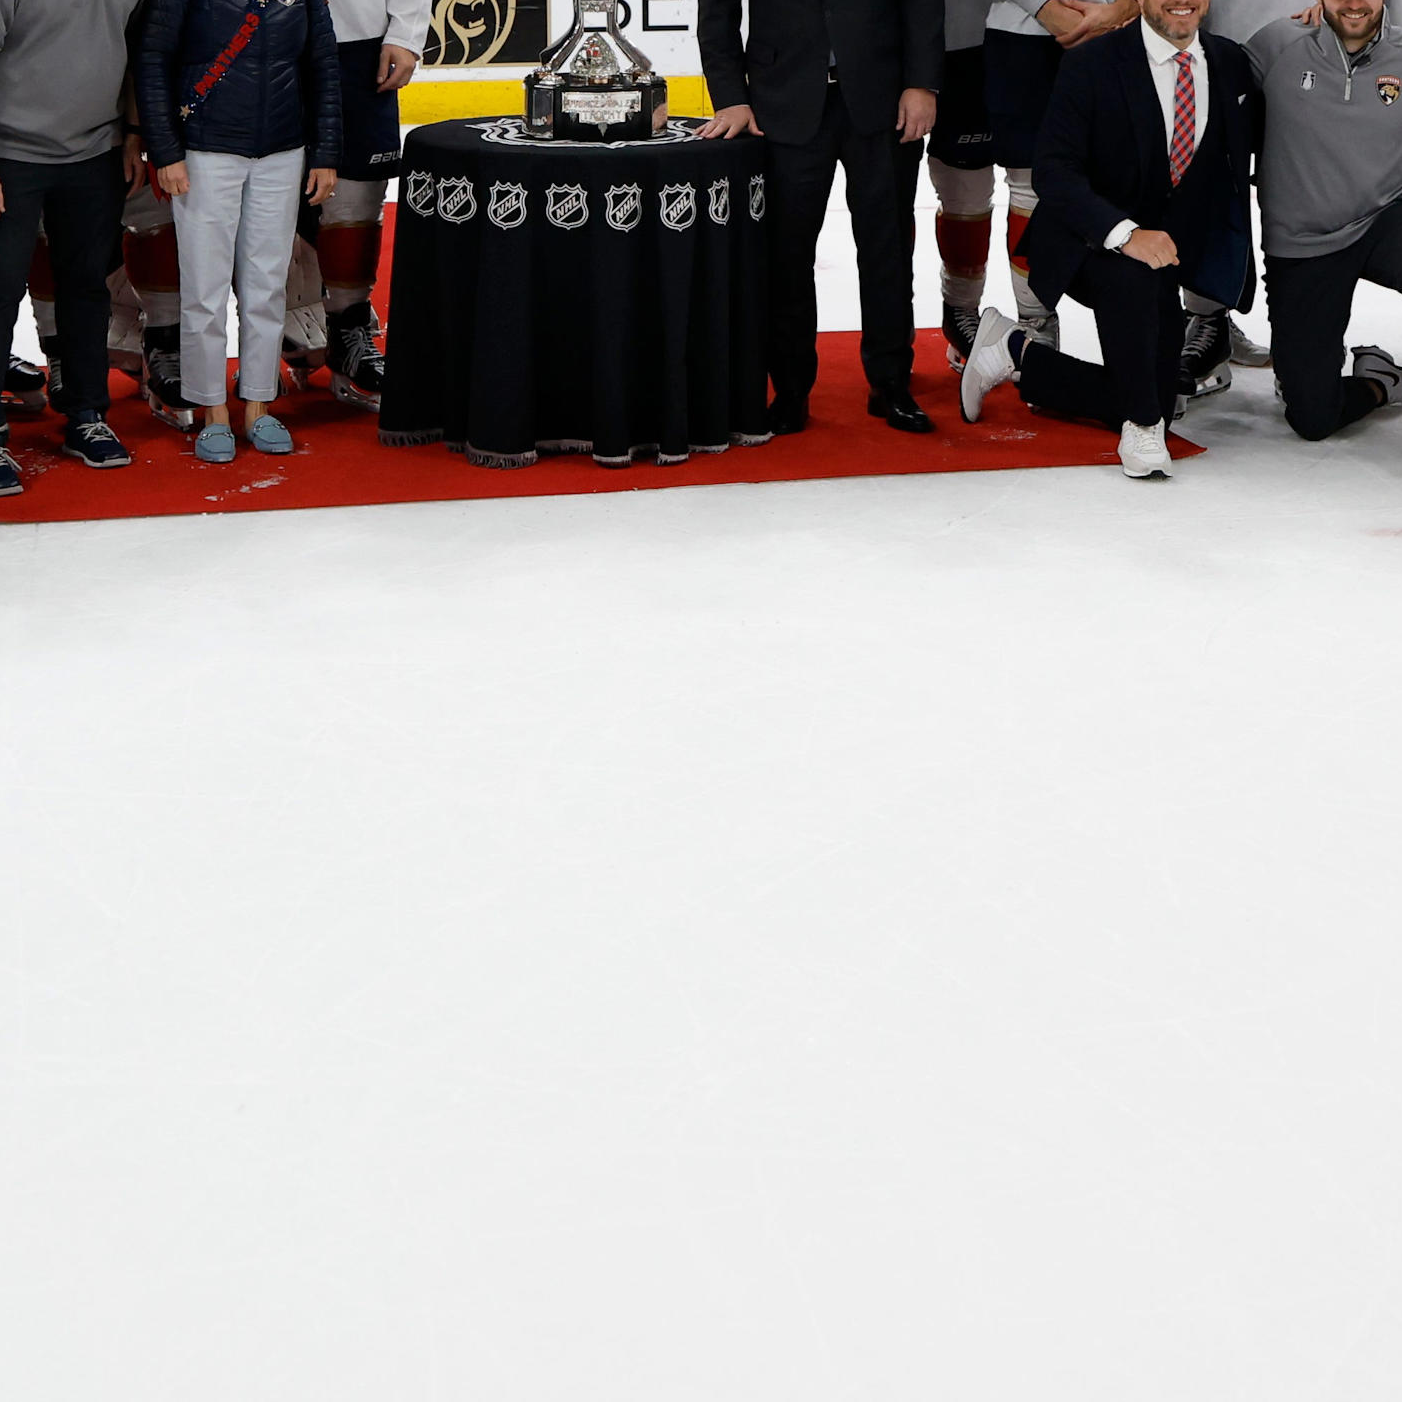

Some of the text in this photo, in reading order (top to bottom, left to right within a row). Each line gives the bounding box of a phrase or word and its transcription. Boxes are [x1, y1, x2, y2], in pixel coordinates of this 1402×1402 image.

[446, 189, 469, 213] NHL
[496, 197, 519, 218] NHL
[555, 198, 579, 219] NHL
[615, 198, 636, 220] NHL
[667, 198, 689, 220] NHL
